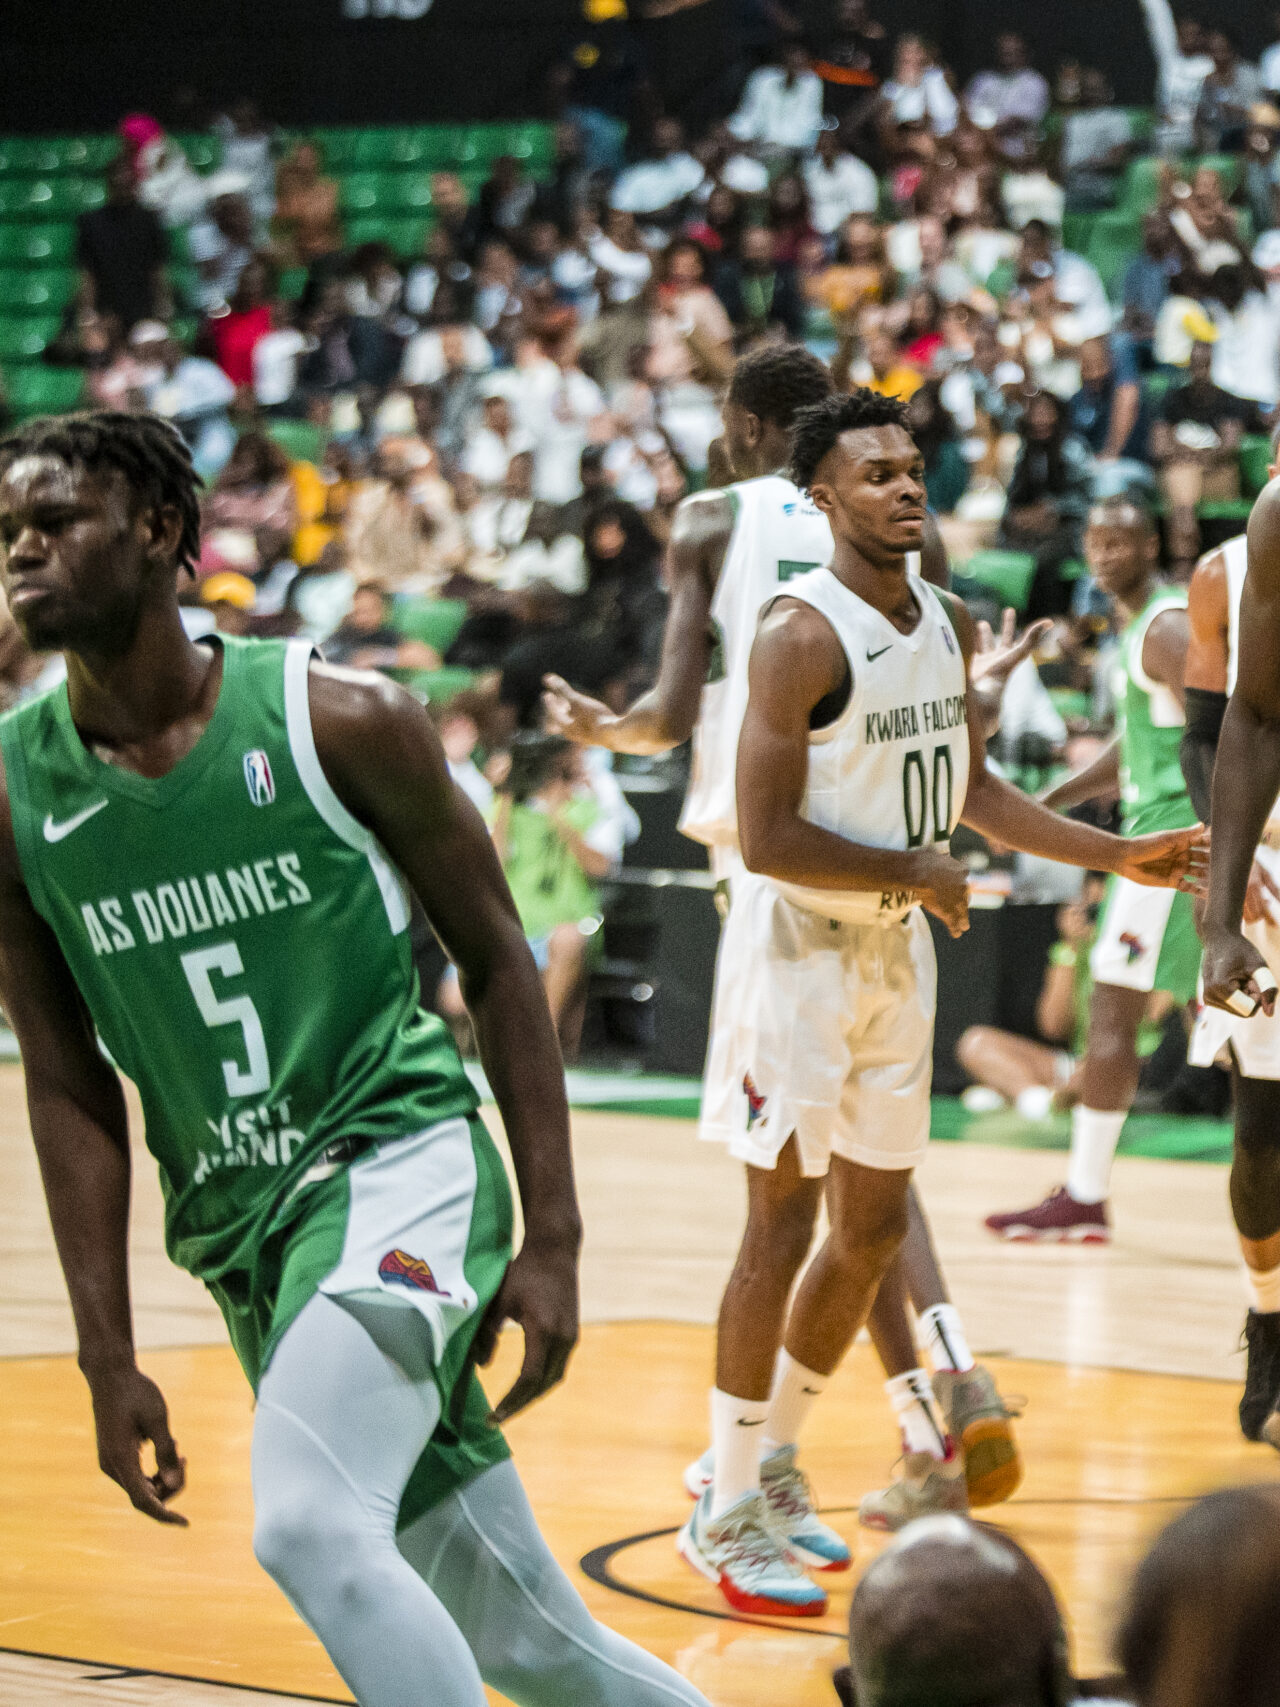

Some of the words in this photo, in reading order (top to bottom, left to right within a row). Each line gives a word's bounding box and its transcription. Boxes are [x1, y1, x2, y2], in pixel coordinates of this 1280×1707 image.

[866, 705, 920, 745] KWARA
[923, 693, 967, 733] FALCON
[903, 744, 953, 847] 00
[81, 898, 136, 956] AS
[131, 852, 311, 944] DOUANES
[180, 940, 271, 1097] 5
